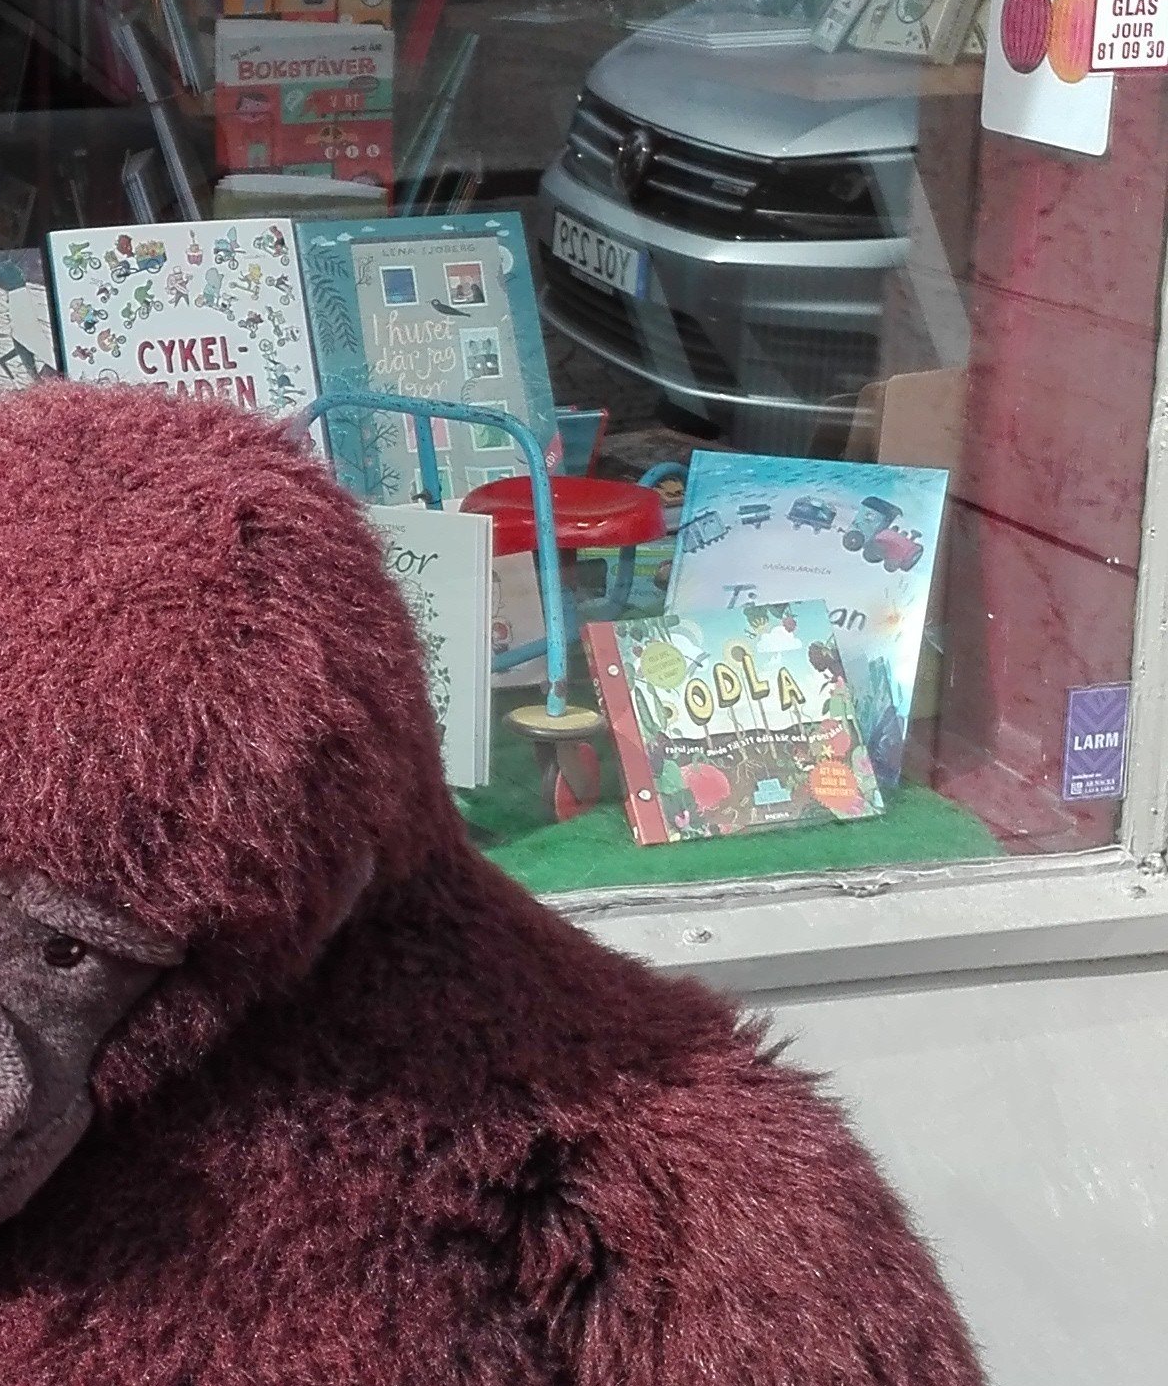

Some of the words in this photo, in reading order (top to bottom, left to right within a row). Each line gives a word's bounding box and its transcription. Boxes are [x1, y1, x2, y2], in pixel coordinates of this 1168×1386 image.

[1112, 22, 1153, 38] JOUR
[1097, 42, 1114, 60] 81
[1122, 41, 1140, 59] 09
[1146, 40, 1165, 58] 30
[237, 55, 377, 81] BOKSTÄVER
[381, 247, 415, 257] LENA
[372, 313, 379, 346] I
[386, 309, 456, 347] huset
[137, 335, 248, 375] CYKEL-
[375, 347, 420, 375] där
[416, 346, 456, 380] jag
[153, 375, 258, 411] ADEN
[397, 372, 448, 398] bor
[684, 653, 807, 726] ODLA
[1073, 731, 1119, 751] LARM
